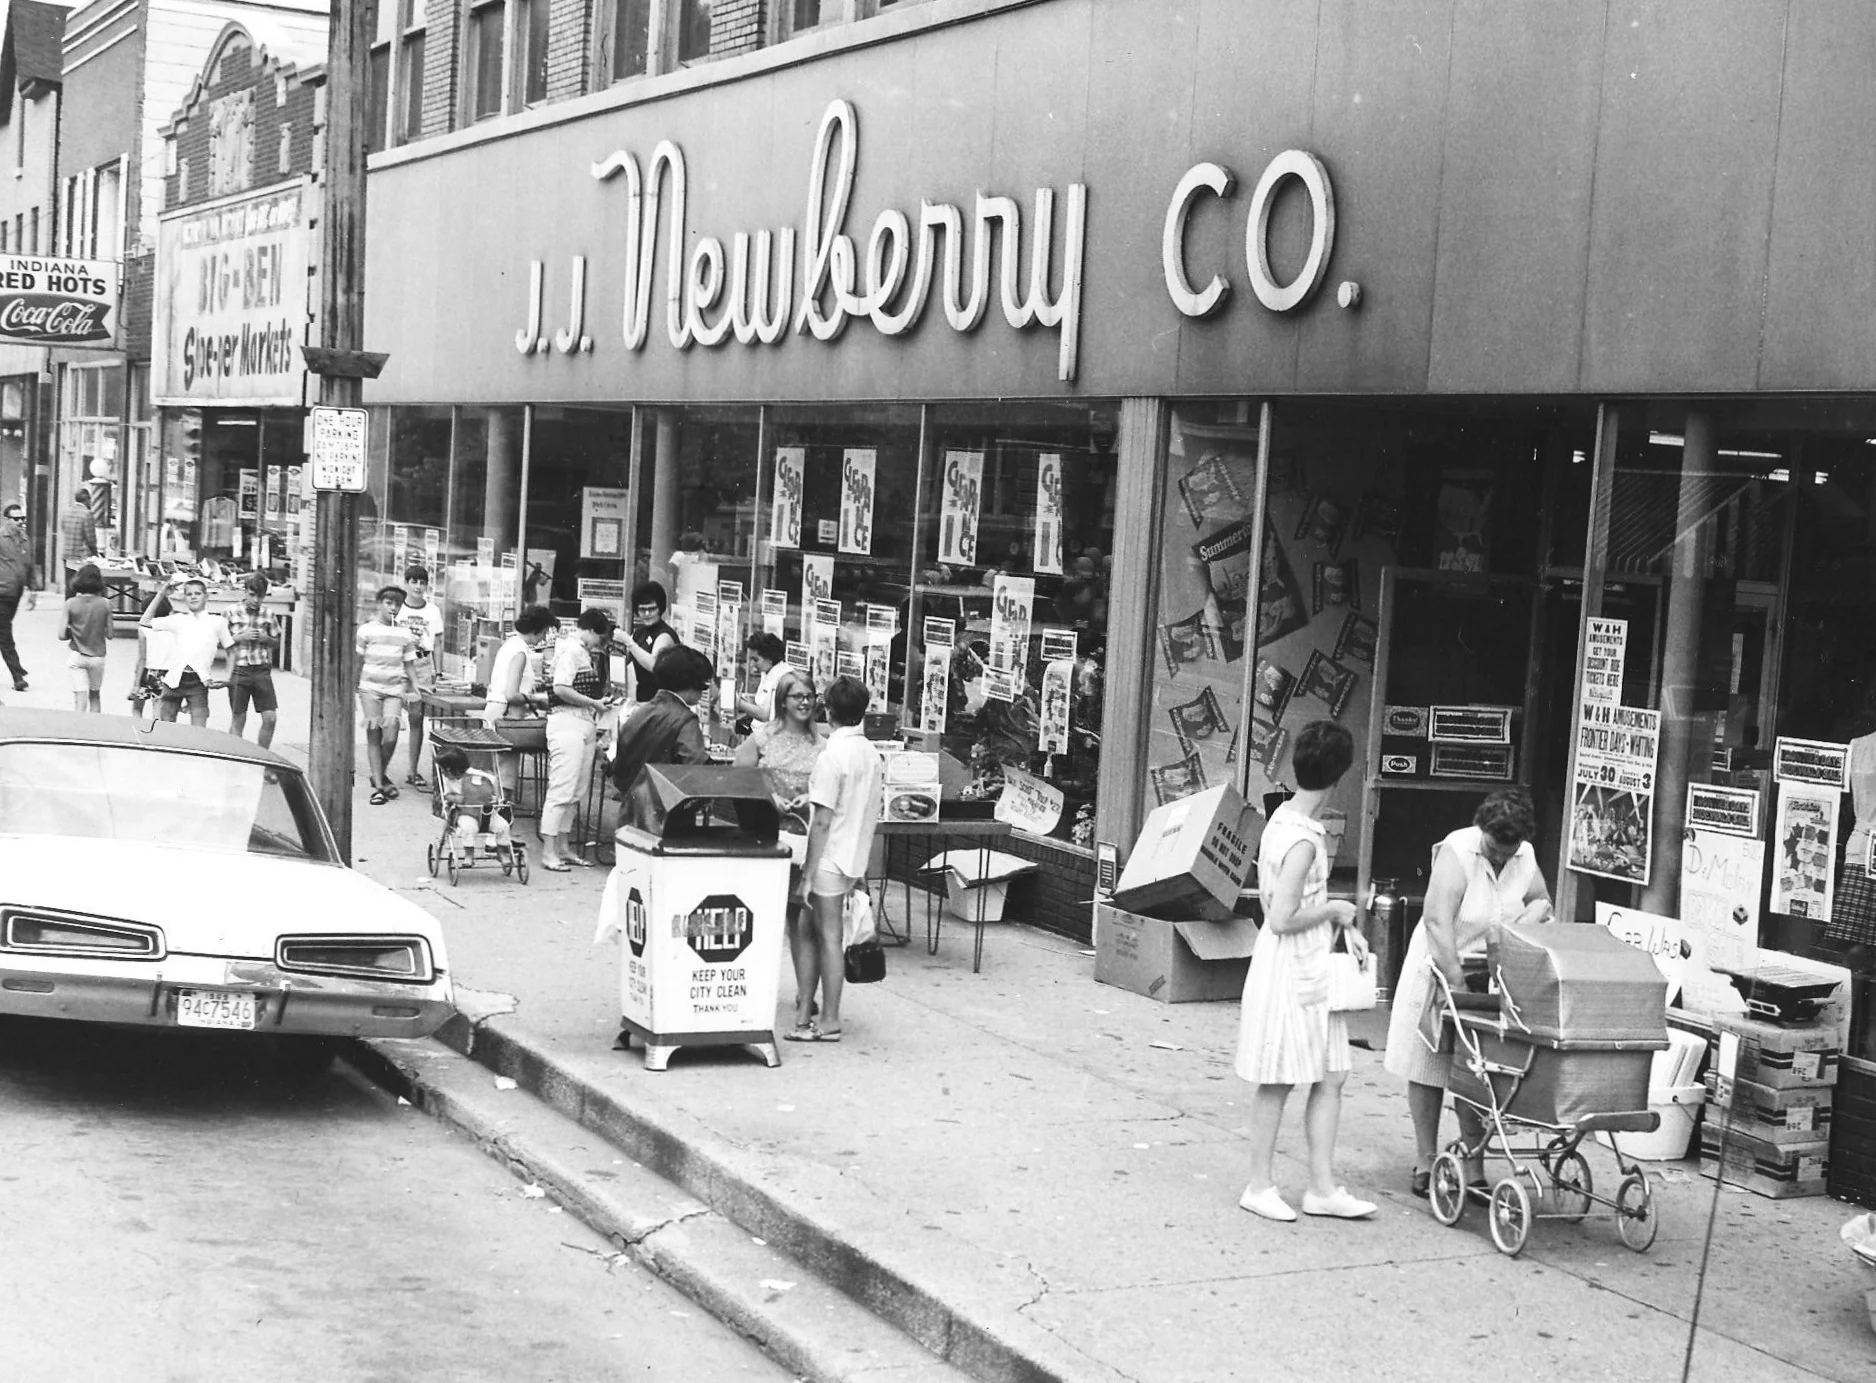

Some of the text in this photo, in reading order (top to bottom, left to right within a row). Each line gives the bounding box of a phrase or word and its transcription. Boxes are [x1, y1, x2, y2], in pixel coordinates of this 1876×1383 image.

[590, 99, 1086, 381] Newberry
[10, 260, 89, 276] INDIANA
[47, 275, 107, 296] HOTS
[240, 317, 292, 376] Markets
[1593, 622, 1603, 633] W
[1612, 624, 1622, 634] H
[1584, 703, 1594, 721] W
[1602, 706, 1611, 723] H
[1612, 707, 1657, 731] AMUSEMENTS
[1580, 726, 1609, 750] FRONTIER
[1609, 731, 1626, 753] DAYS
[1577, 768, 1599, 780] JULY
[1600, 765, 1616, 782] 30
[1619, 774, 1641, 788] AUGUST
[1642, 772, 1652, 789] 3
[1217, 821, 1248, 855] FRAGILE
[692, 968, 746, 982] KEEP YOUR
[690, 984, 747, 999] CITY CLEAN
[183, 999, 251, 1020] 94C7546
[693, 1003, 739, 1013] THANK YOU
